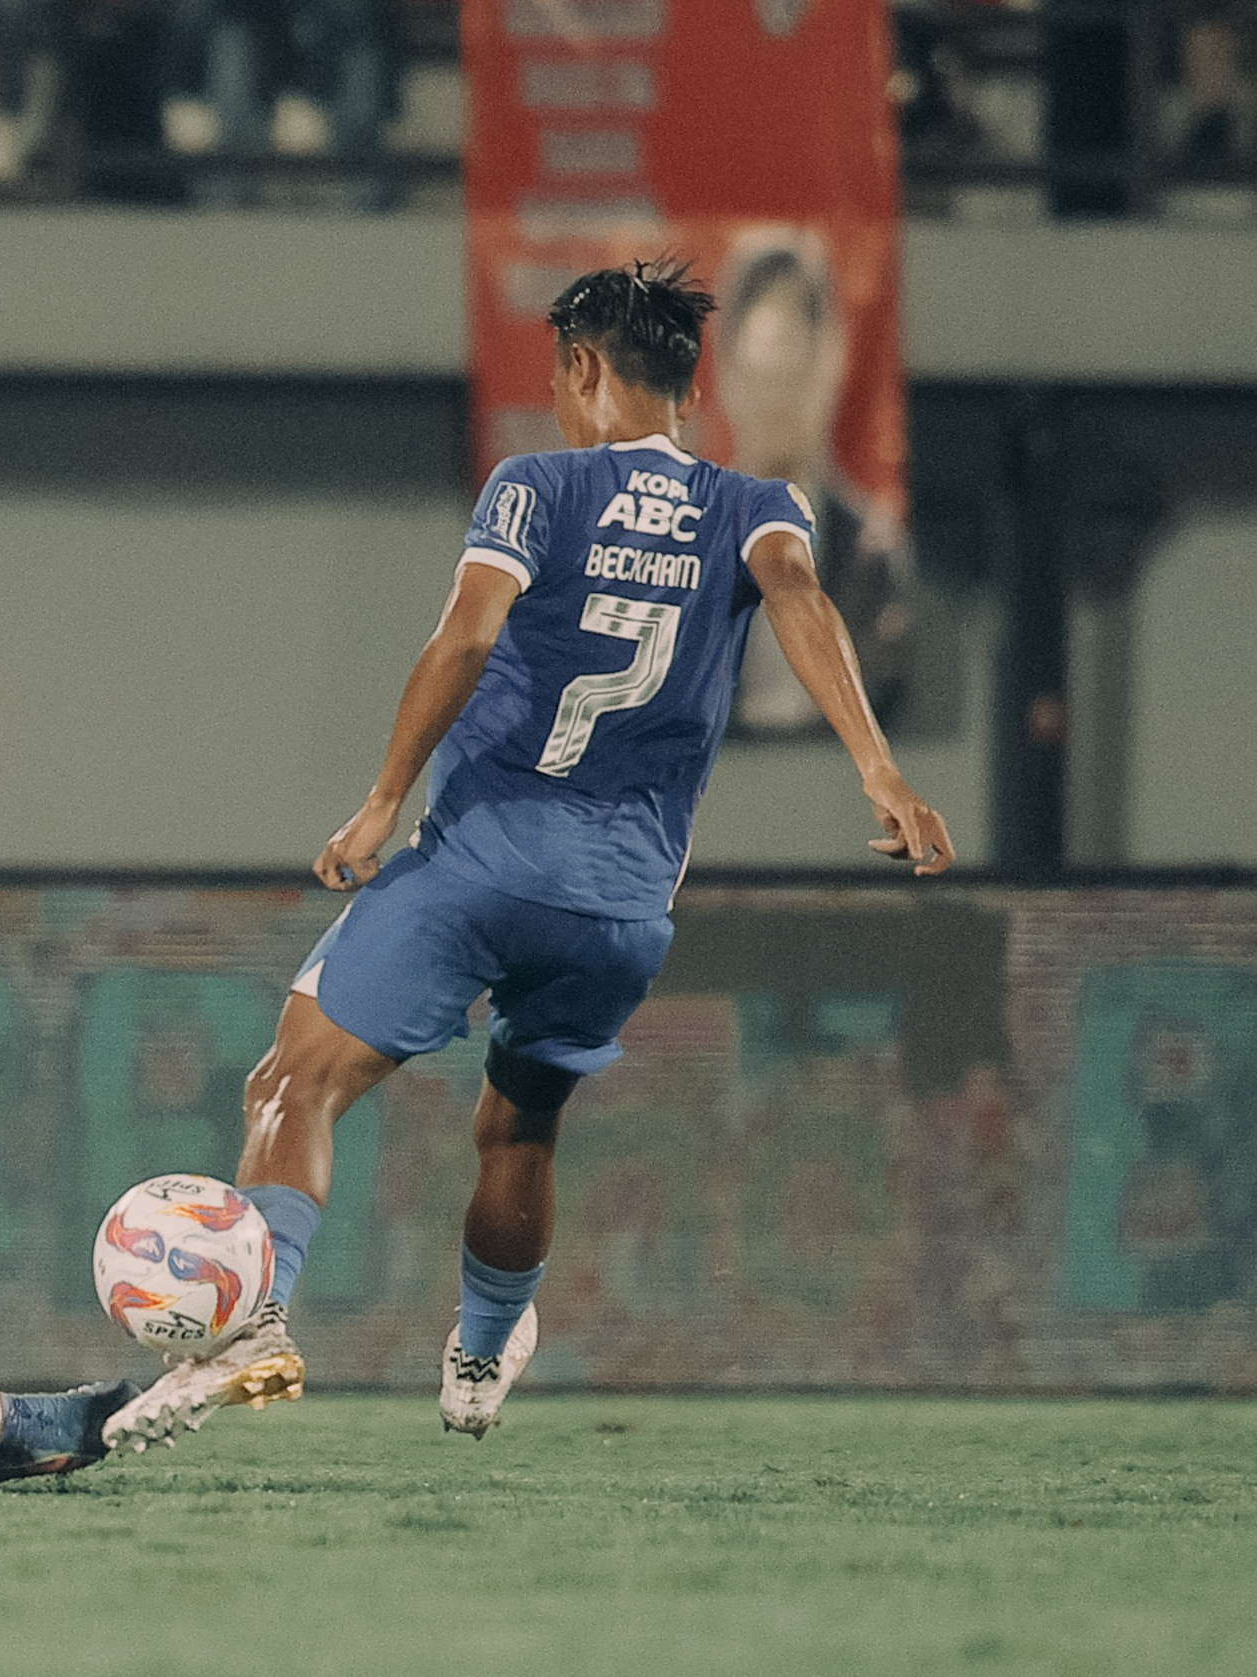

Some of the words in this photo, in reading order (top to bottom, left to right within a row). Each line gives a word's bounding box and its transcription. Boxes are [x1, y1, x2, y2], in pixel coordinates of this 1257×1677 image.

[597, 492, 703, 542] ABC
[585, 543, 702, 590] BECKHAM
[535, 593, 681, 777] 7
[143, 1321, 204, 1339] SPECS
